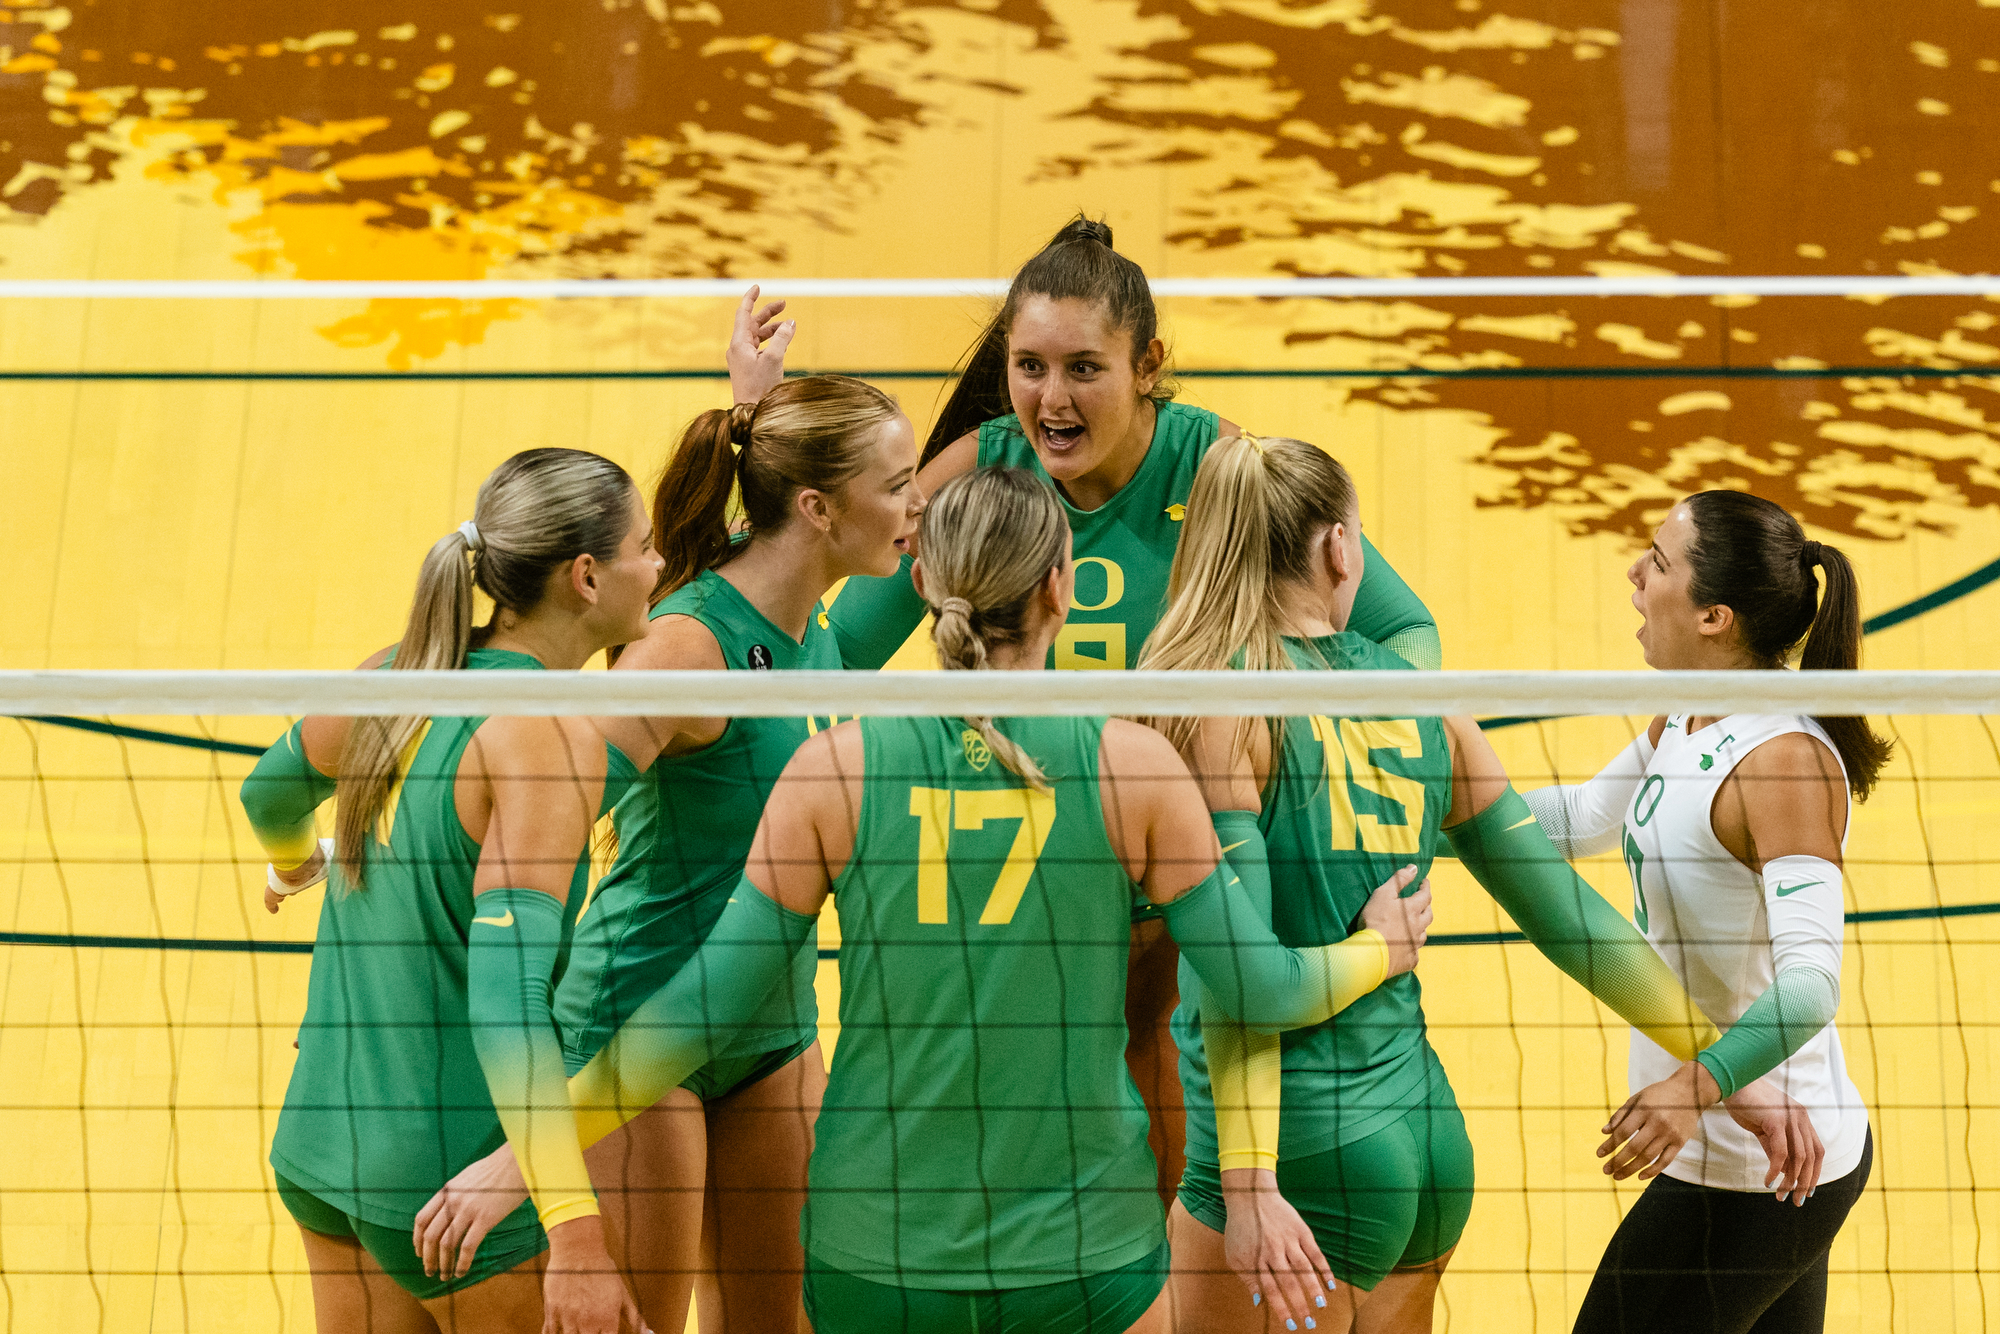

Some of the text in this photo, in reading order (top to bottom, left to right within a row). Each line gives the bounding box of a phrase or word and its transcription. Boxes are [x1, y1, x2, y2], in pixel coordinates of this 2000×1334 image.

[1069, 557, 1125, 611] O
[971, 747, 988, 763] 12
[1309, 714, 1426, 854] 15
[909, 786, 1057, 925] 17
